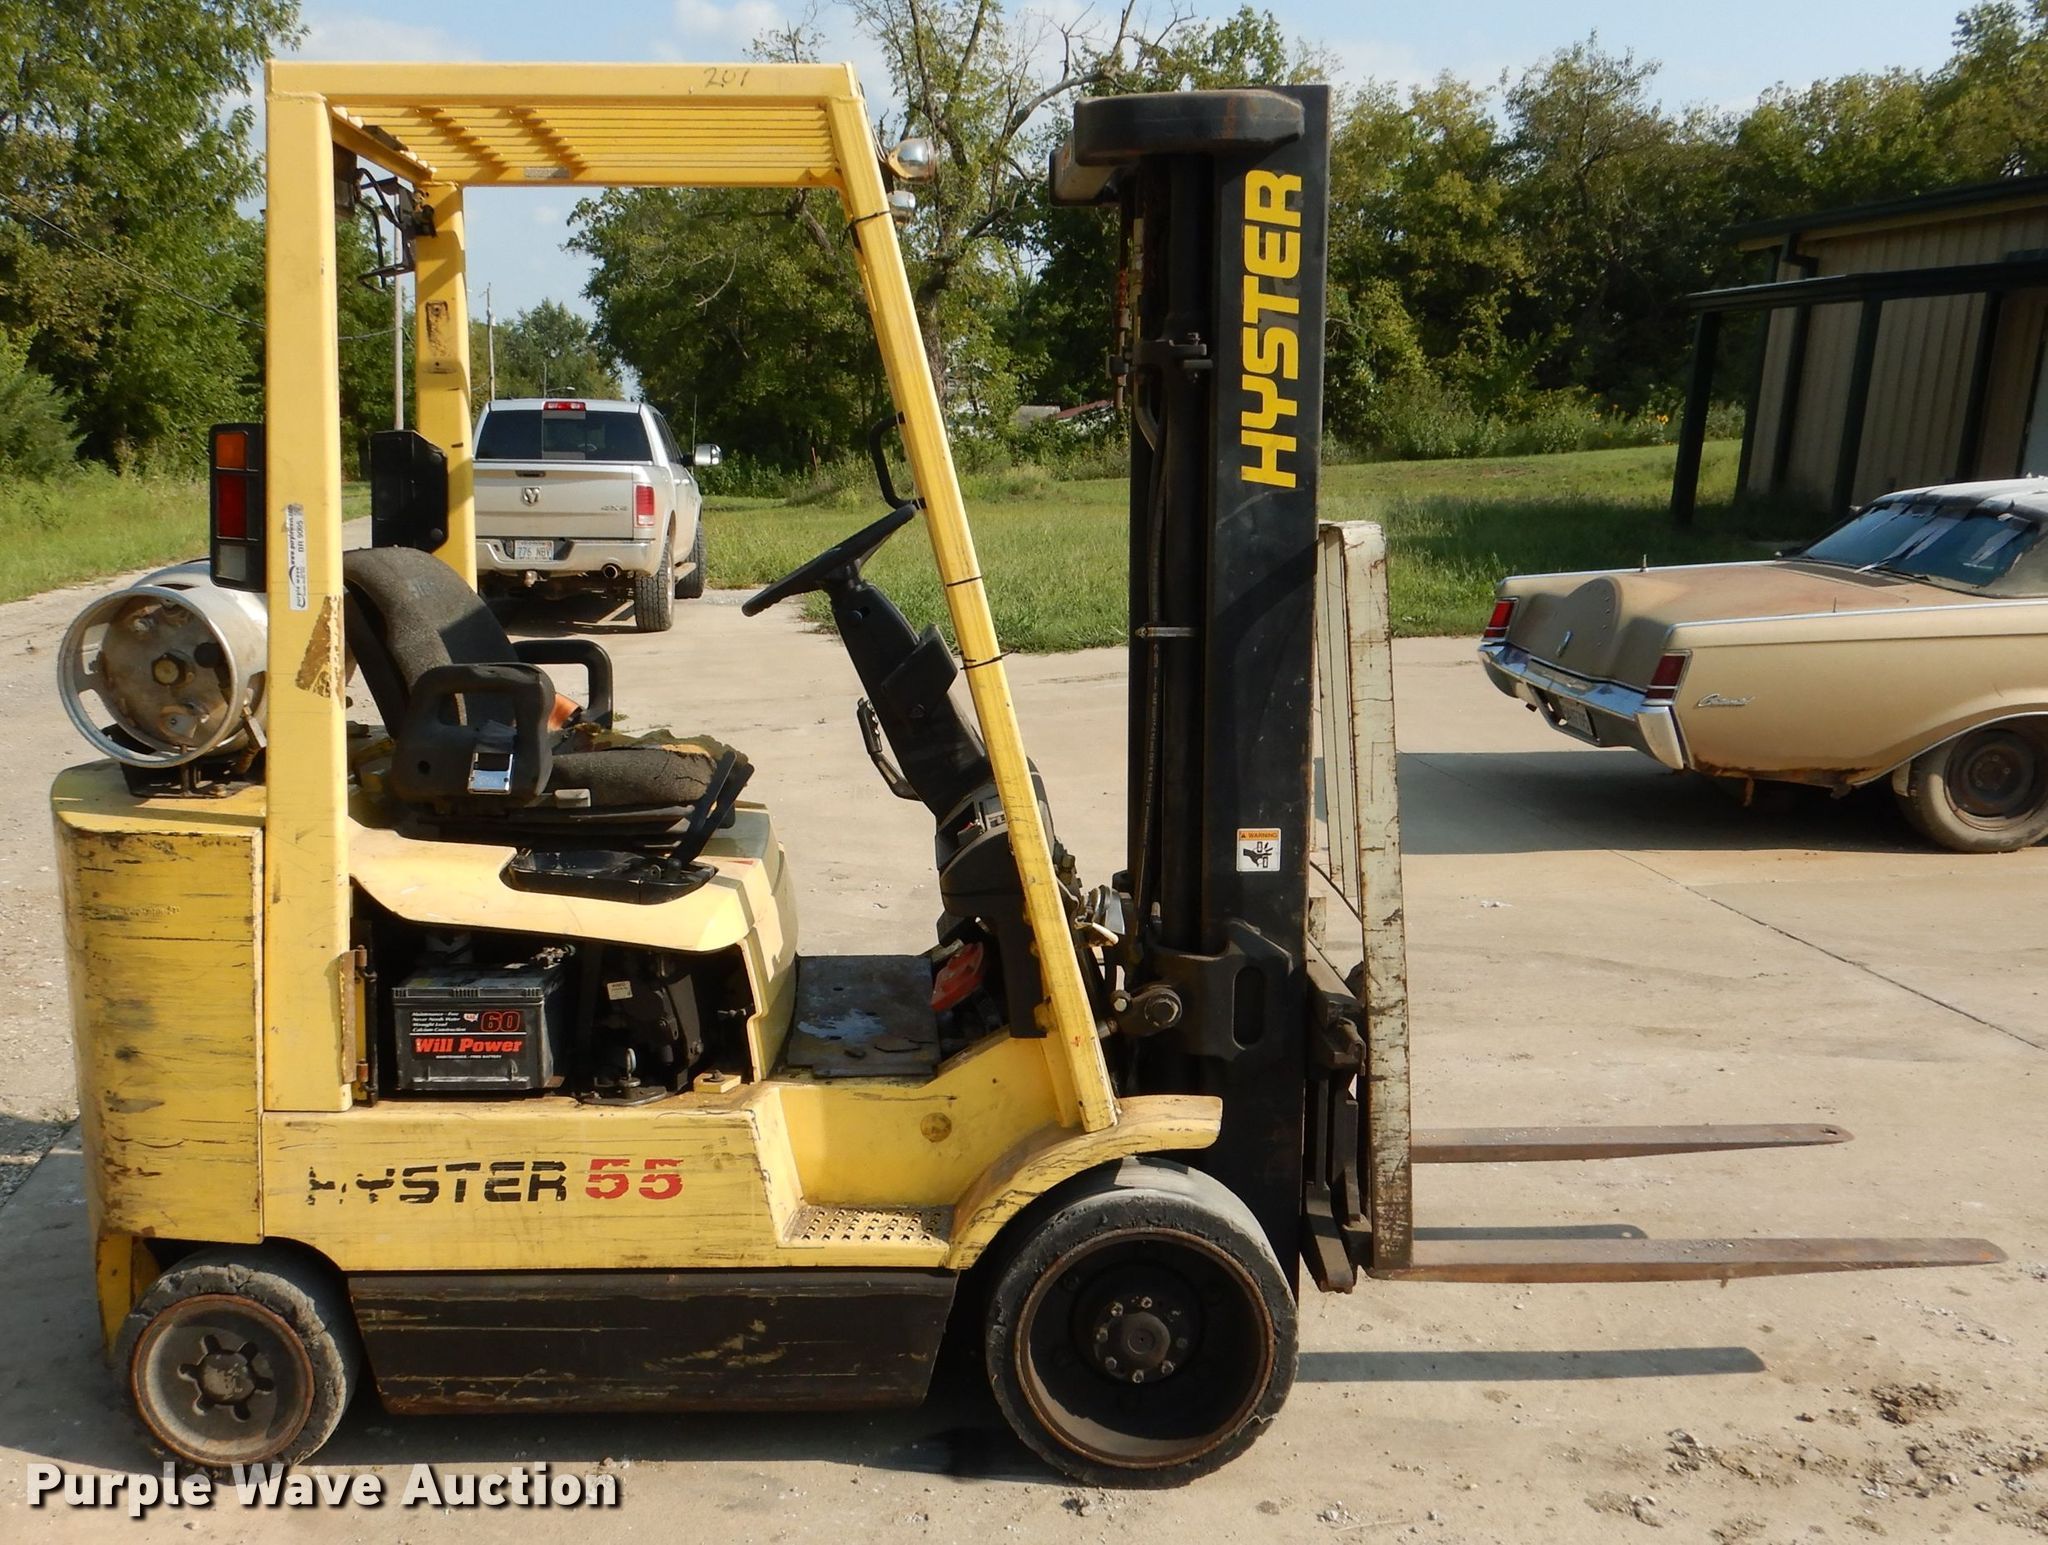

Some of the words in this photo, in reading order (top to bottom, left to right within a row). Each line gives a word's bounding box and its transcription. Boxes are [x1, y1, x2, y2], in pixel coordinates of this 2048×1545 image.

[1241, 169, 1302, 489] HYSTER
[1248, 831, 1278, 839] WARNING
[480, 1011, 521, 1032] 60
[415, 1038, 454, 1053] Will
[458, 1038, 522, 1053] Power
[585, 1158, 685, 1200] 55
